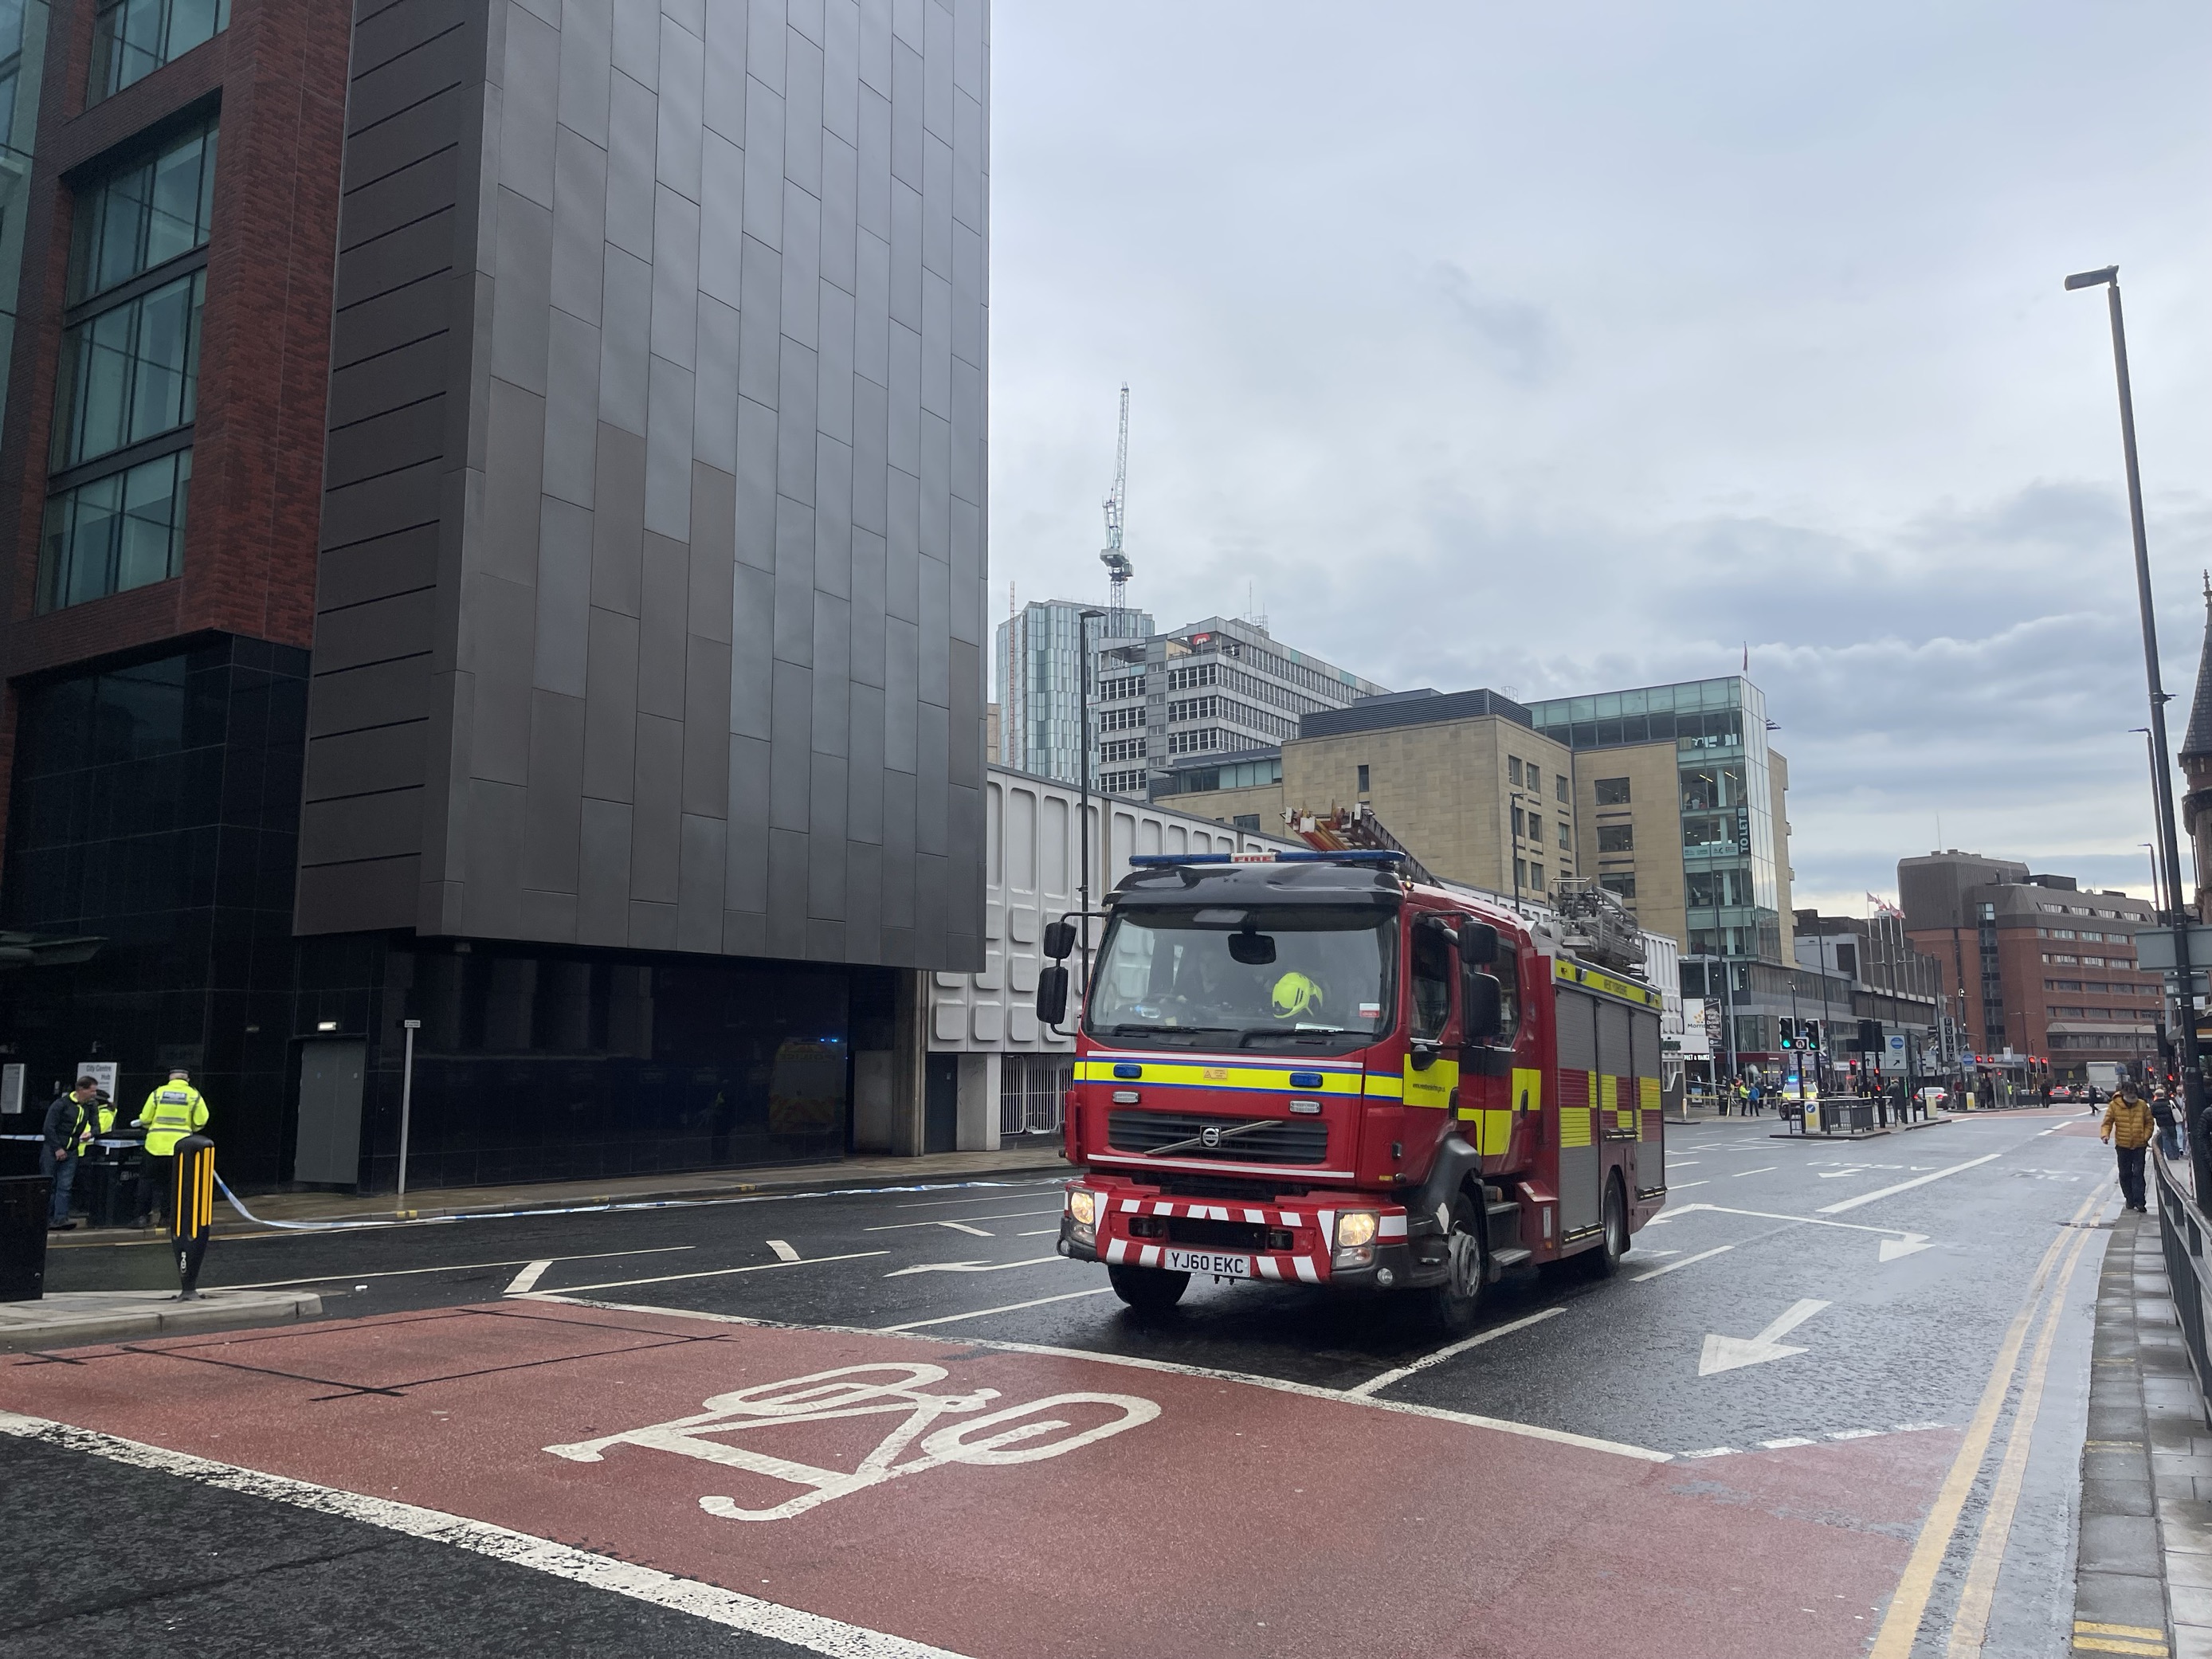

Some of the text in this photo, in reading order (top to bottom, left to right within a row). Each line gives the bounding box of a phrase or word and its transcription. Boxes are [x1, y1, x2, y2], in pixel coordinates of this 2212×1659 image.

[1739, 818, 1749, 853] TO LET
[1945, 1018, 1955, 1061] PRYZM
[1171, 1252, 1244, 1273] YJ60 EKC
